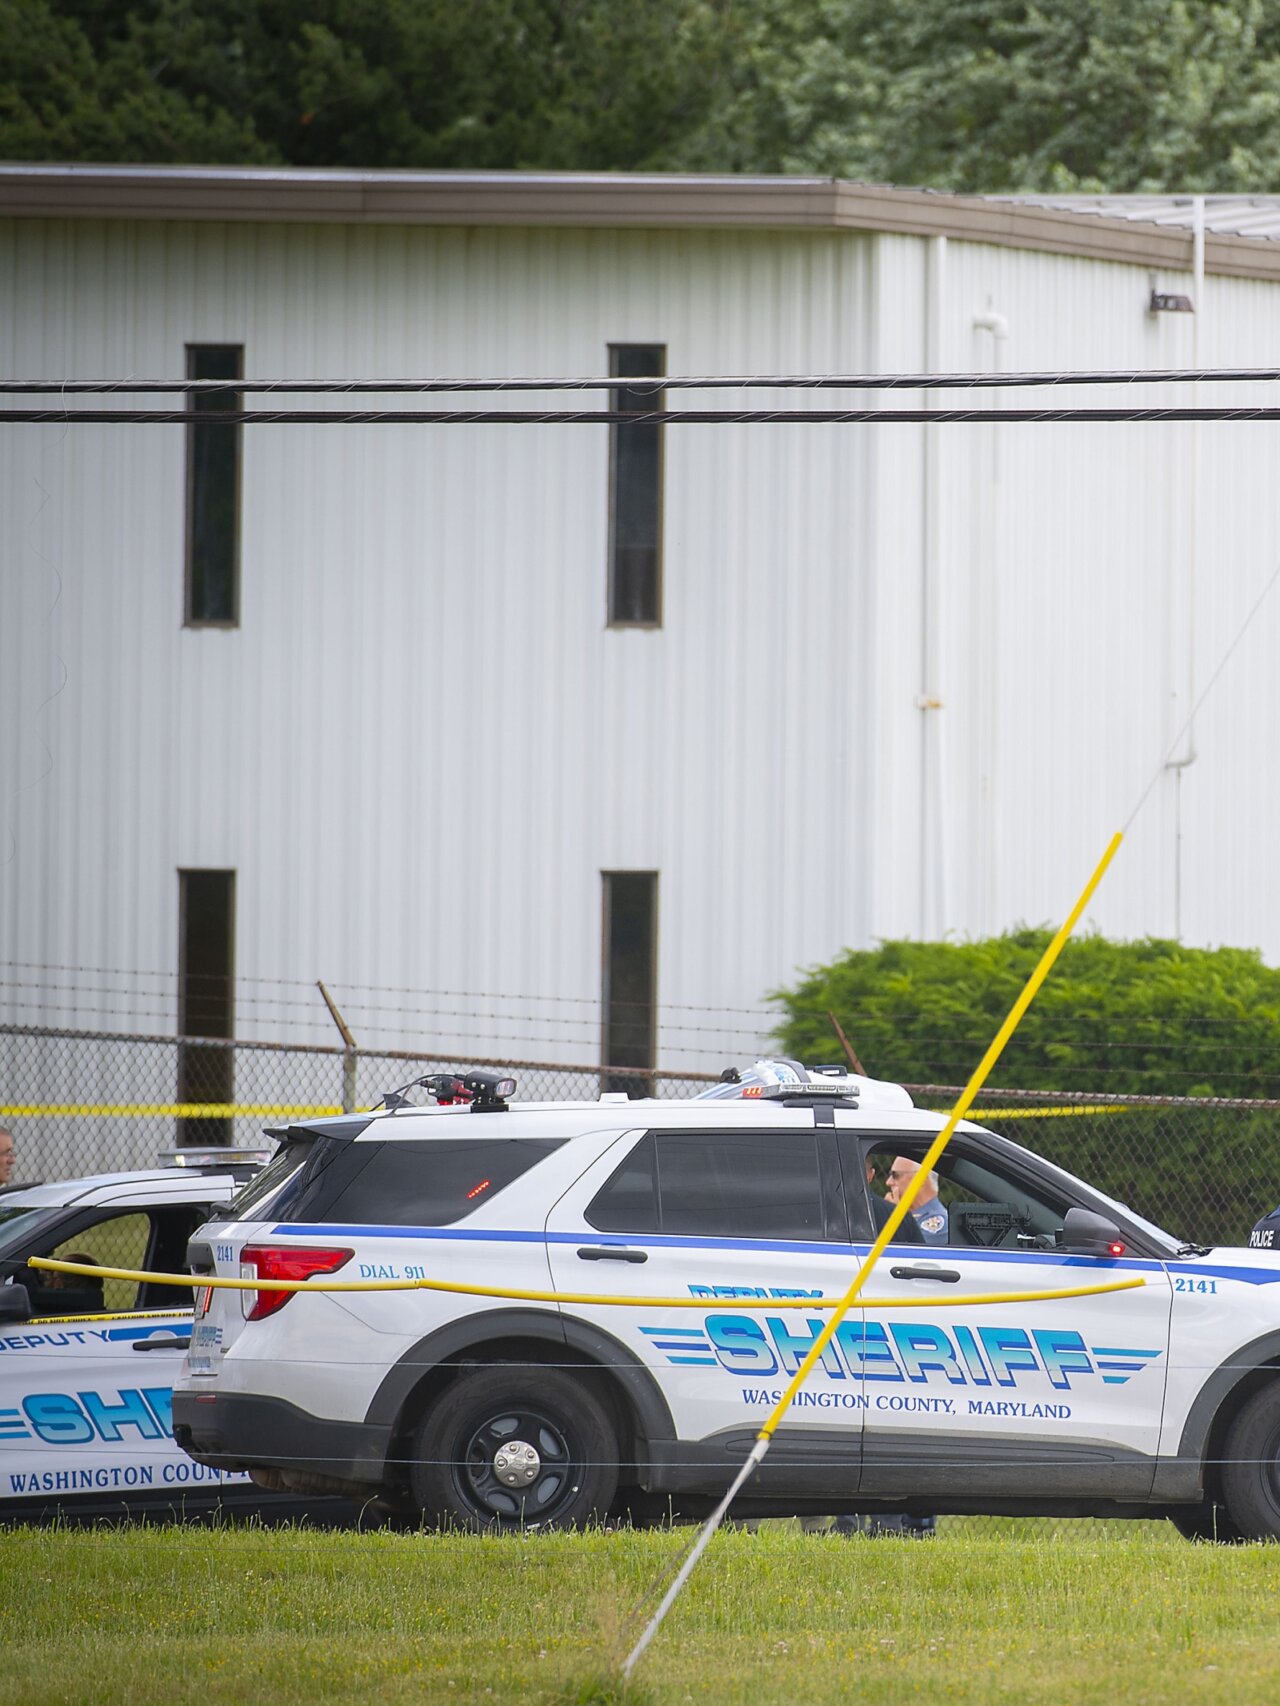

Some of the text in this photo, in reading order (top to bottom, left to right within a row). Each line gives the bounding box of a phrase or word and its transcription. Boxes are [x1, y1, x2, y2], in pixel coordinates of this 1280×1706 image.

[1249, 1230, 1275, 1247] POLICE
[216, 1246, 233, 1261] 2141
[359, 1264, 426, 1279] DIAL 911
[1175, 1278, 1217, 1294] 2141
[0, 1329, 109, 1351] EPUTY
[704, 1314, 1095, 1390] SHERIFF
[876, 1395, 957, 1416] COUNTY,
[968, 1401, 1071, 1419] MARYLAND
[10, 1466, 152, 1493] WASHINGTON
